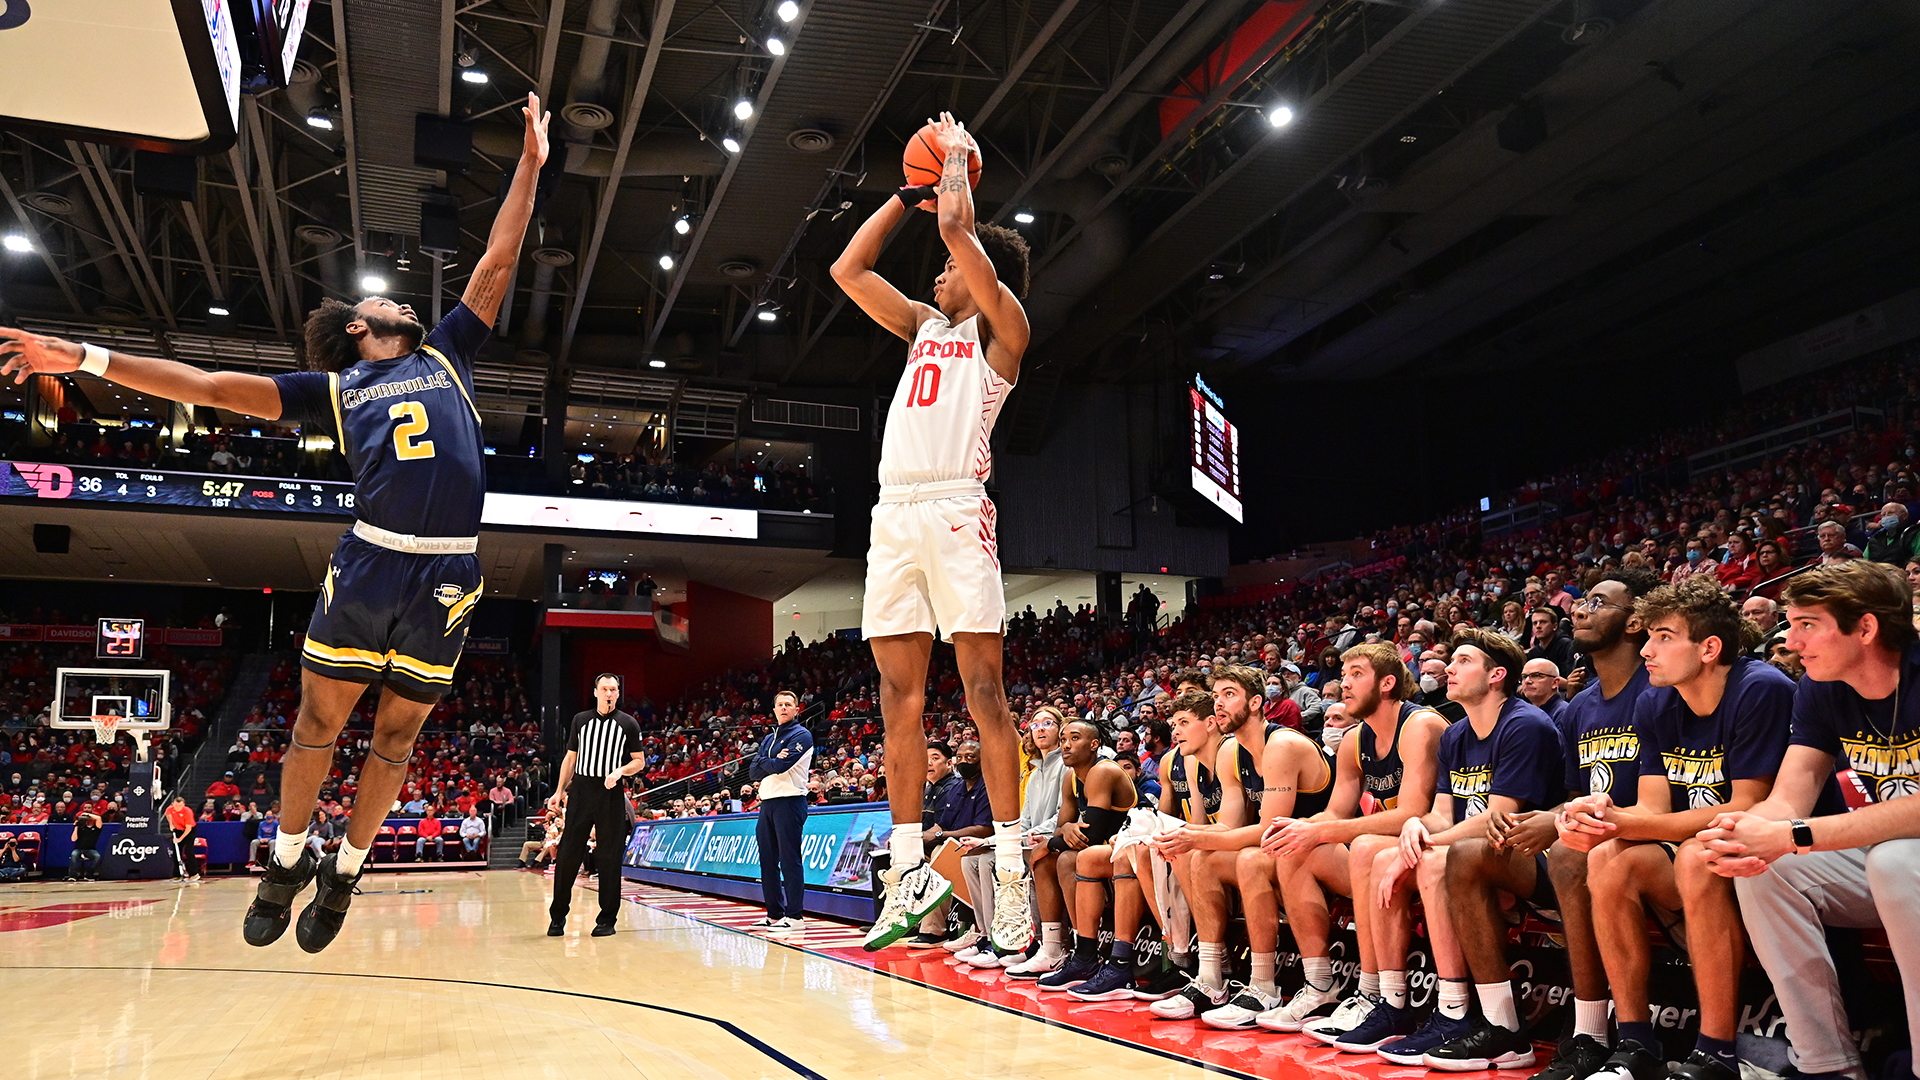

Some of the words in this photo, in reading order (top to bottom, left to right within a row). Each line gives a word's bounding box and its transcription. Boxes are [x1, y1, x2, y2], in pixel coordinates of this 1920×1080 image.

[342, 370, 452, 409] CEDARVILLE
[906, 363, 942, 408] 10
[388, 401, 436, 461] 2
[115, 472, 129, 480] TOL
[140, 474, 164, 482] FOULS
[78, 476, 103, 493] 36
[117, 483, 129, 496] 4
[202, 480, 245, 498] 5:47
[278, 482, 302, 491] FOULS
[310, 484, 324, 492] TOL
[146, 485, 157, 498] 3
[252, 490, 275, 499] POSS
[211, 498, 231, 508] 1ST
[285, 493, 296, 505] 6
[312, 495, 323, 507] 3
[335, 492, 356, 508] 18
[106, 635, 135, 655] 23
[112, 838, 160, 863] Kroger
[703, 835, 743, 863] SENIOR
